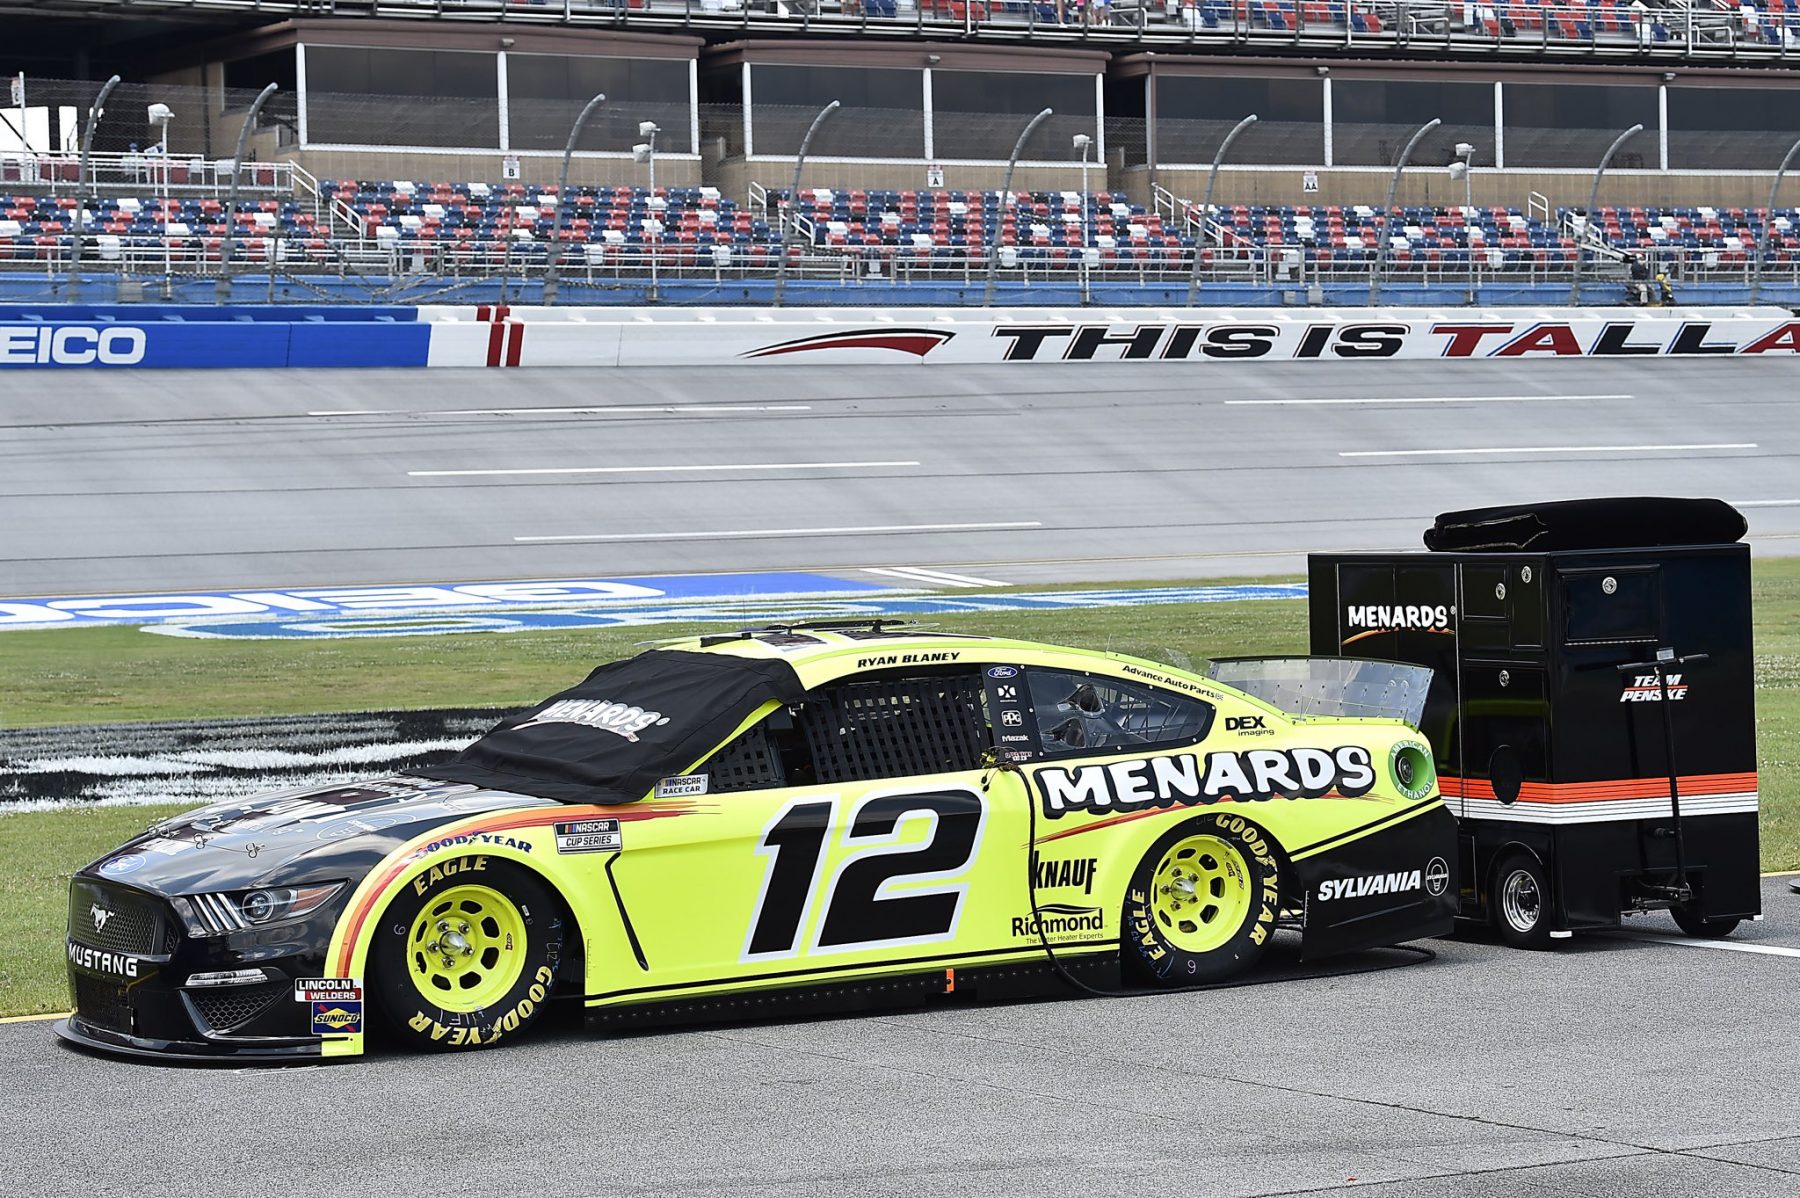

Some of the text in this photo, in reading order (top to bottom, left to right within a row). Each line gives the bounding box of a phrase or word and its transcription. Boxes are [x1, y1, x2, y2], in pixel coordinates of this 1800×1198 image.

[508, 168, 515, 177] B
[933, 177, 940, 185] A
[1305, 182, 1317, 190] AA
[994, 325, 1280, 362] THIS
[1294, 324, 1411, 361] IS
[1347, 605, 1448, 628] MENARDS
[857, 651, 960, 669] RYAN BLANEY
[993, 667, 1012, 677] Ford
[1122, 665, 1215, 698] Advance Auto Parts
[1634, 674, 1682, 687] TEAM
[536, 699, 661, 733] MENARDS
[1004, 712, 1021, 724] PPG
[1225, 716, 1266, 731] DEX
[1002, 734, 1029, 742] Mazak
[1238, 729, 1275, 737] imaging
[1391, 741, 1429, 760] AMERICAN
[671, 777, 701, 787] NASCAR
[1037, 747, 1375, 815] MENARDS
[662, 787, 683, 795] RACE
[1397, 780, 1433, 799] ETHANOL
[576, 821, 609, 834] NASCAR
[566, 835, 612, 847] CUP SERIES
[413, 856, 489, 897] EAGLE
[744, 786, 987, 961] 12
[1033, 850, 1097, 894] KNAUF
[1215, 813, 1279, 946] GOODYEAR
[1317, 869, 1421, 901] SYLVANIA
[1012, 908, 1103, 937] Richmond
[1132, 888, 1166, 961] EAGLE
[1058, 934, 1078, 942] Heater
[1079, 932, 1104, 941] Experts
[68, 942, 139, 978] MUSTANG
[299, 979, 351, 990] LINCOLN
[310, 991, 356, 1001] WELDERS
[408, 965, 553, 1046] GOODYEAR
[315, 1013, 360, 1024] SUNOCO
